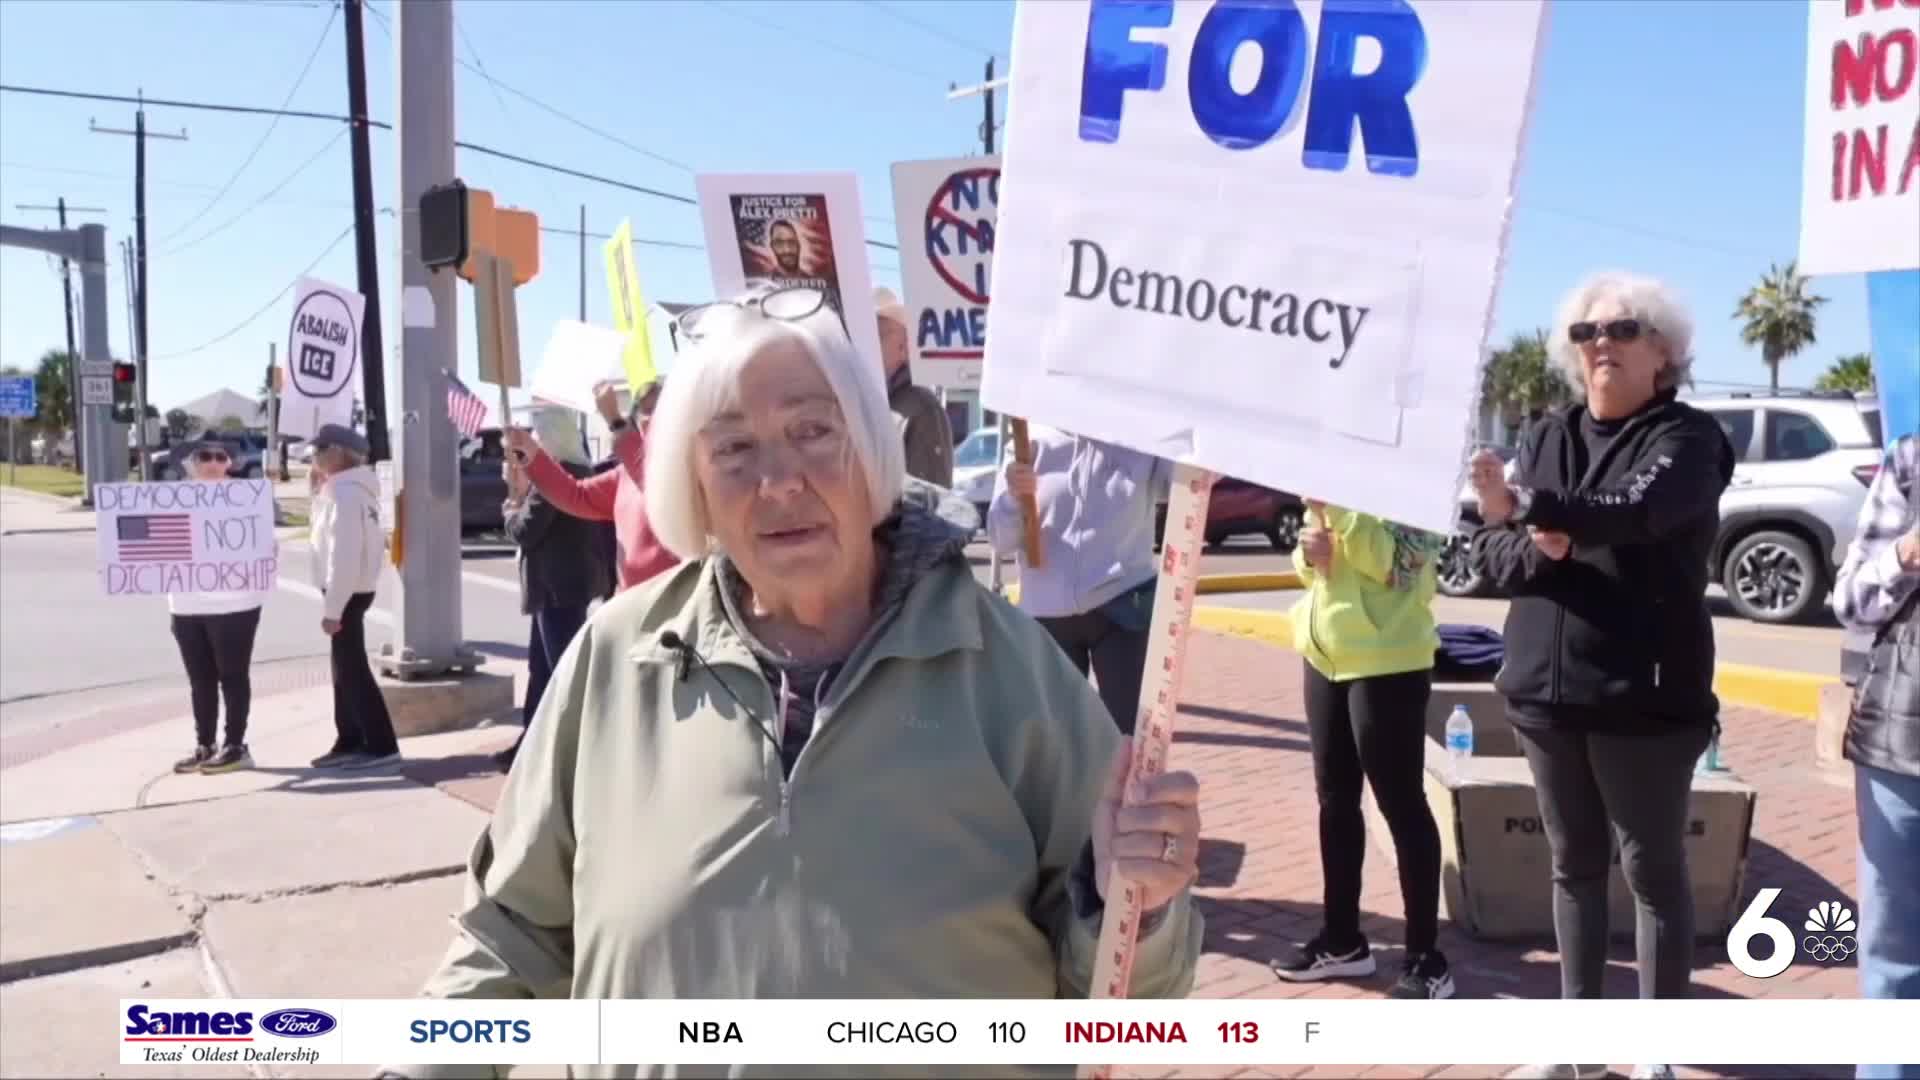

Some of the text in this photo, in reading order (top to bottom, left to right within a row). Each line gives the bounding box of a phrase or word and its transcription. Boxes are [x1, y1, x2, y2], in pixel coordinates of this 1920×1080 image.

[1831, 28, 1918, 110] NO
[1079, 0, 1429, 177] FOR
[1832, 124, 1888, 201] IN
[739, 207, 770, 219] ALEX
[741, 197, 806, 208] JUSTICE FOR
[1065, 239, 1369, 369] Democracy
[297, 313, 349, 347] ABOLISH
[917, 307, 986, 348] AME
[303, 349, 332, 377] ICE
[99, 480, 266, 511] DEMOCRACY
[204, 514, 261, 551] NOT
[107, 558, 278, 595] DICTATORSHIP
